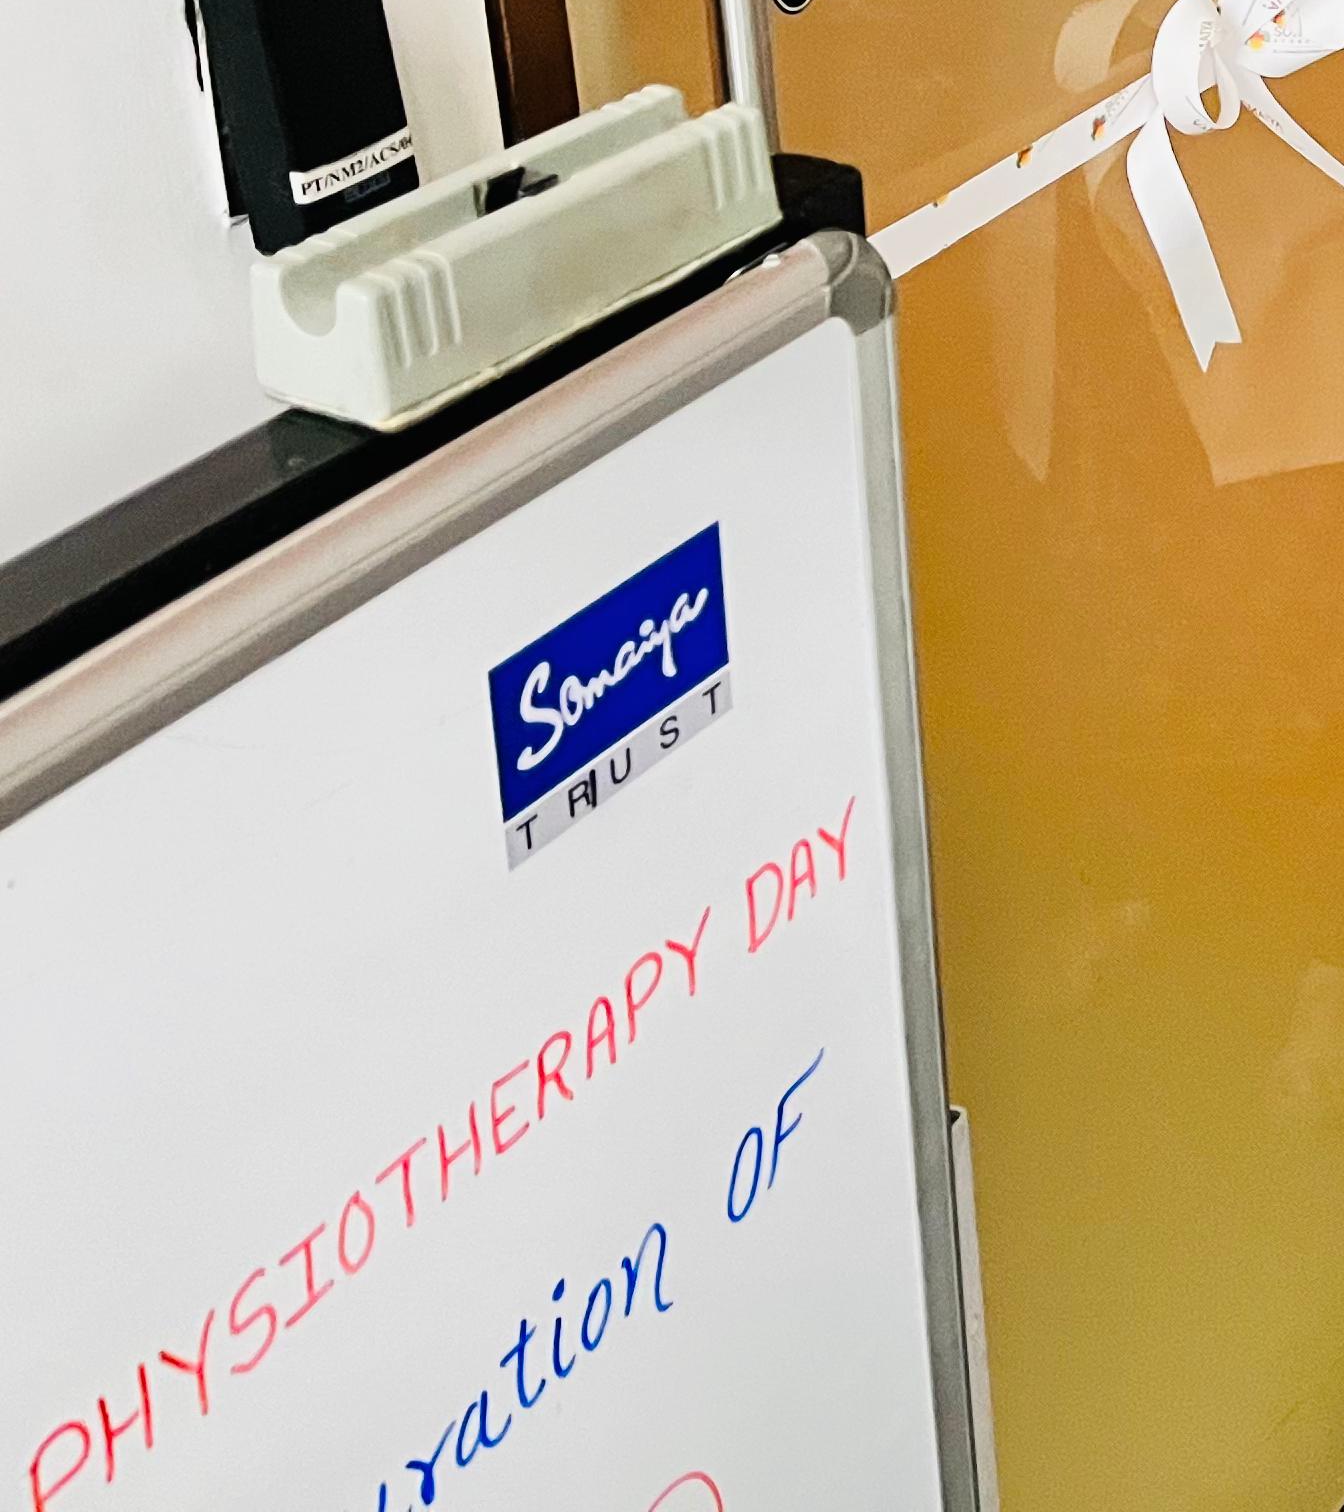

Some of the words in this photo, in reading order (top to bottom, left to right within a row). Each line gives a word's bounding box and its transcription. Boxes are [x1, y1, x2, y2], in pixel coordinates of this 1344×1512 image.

[515, 681, 722, 851] TRUST
[516, 587, 709, 772] Somaiya
[29, 906, 711, 1512] PHYSIOTHERAPY
[744, 796, 856, 954] DAY
[725, 1047, 825, 1222] OF
